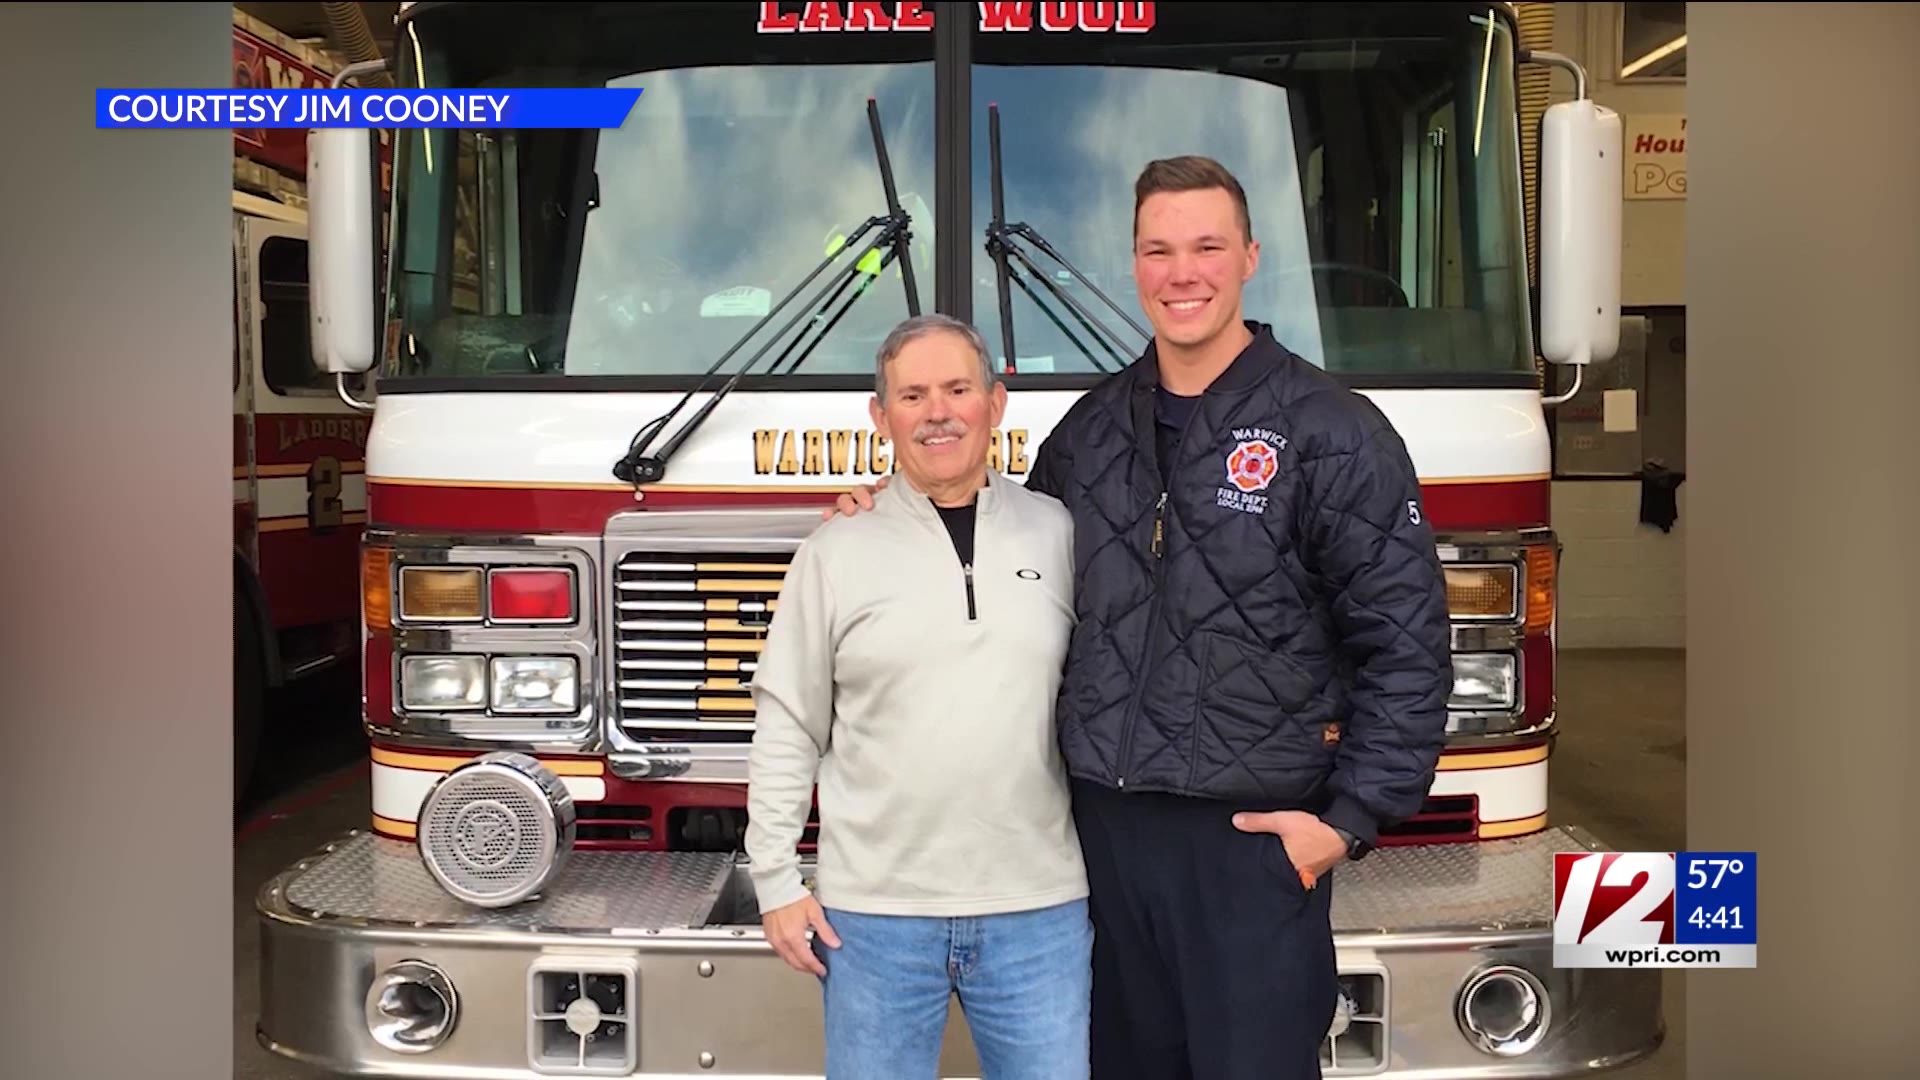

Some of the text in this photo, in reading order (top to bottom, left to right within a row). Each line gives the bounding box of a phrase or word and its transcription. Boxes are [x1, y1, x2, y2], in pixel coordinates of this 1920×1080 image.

[278, 419, 366, 453] LADDER
[1231, 427, 1288, 451] WARWICK
[753, 430, 901, 475] WARWIC
[307, 456, 342, 529] 2
[1217, 487, 1241, 502] FIRE
[1217, 498, 1245, 511] LOCAL
[1407, 500, 1421, 525] 5
